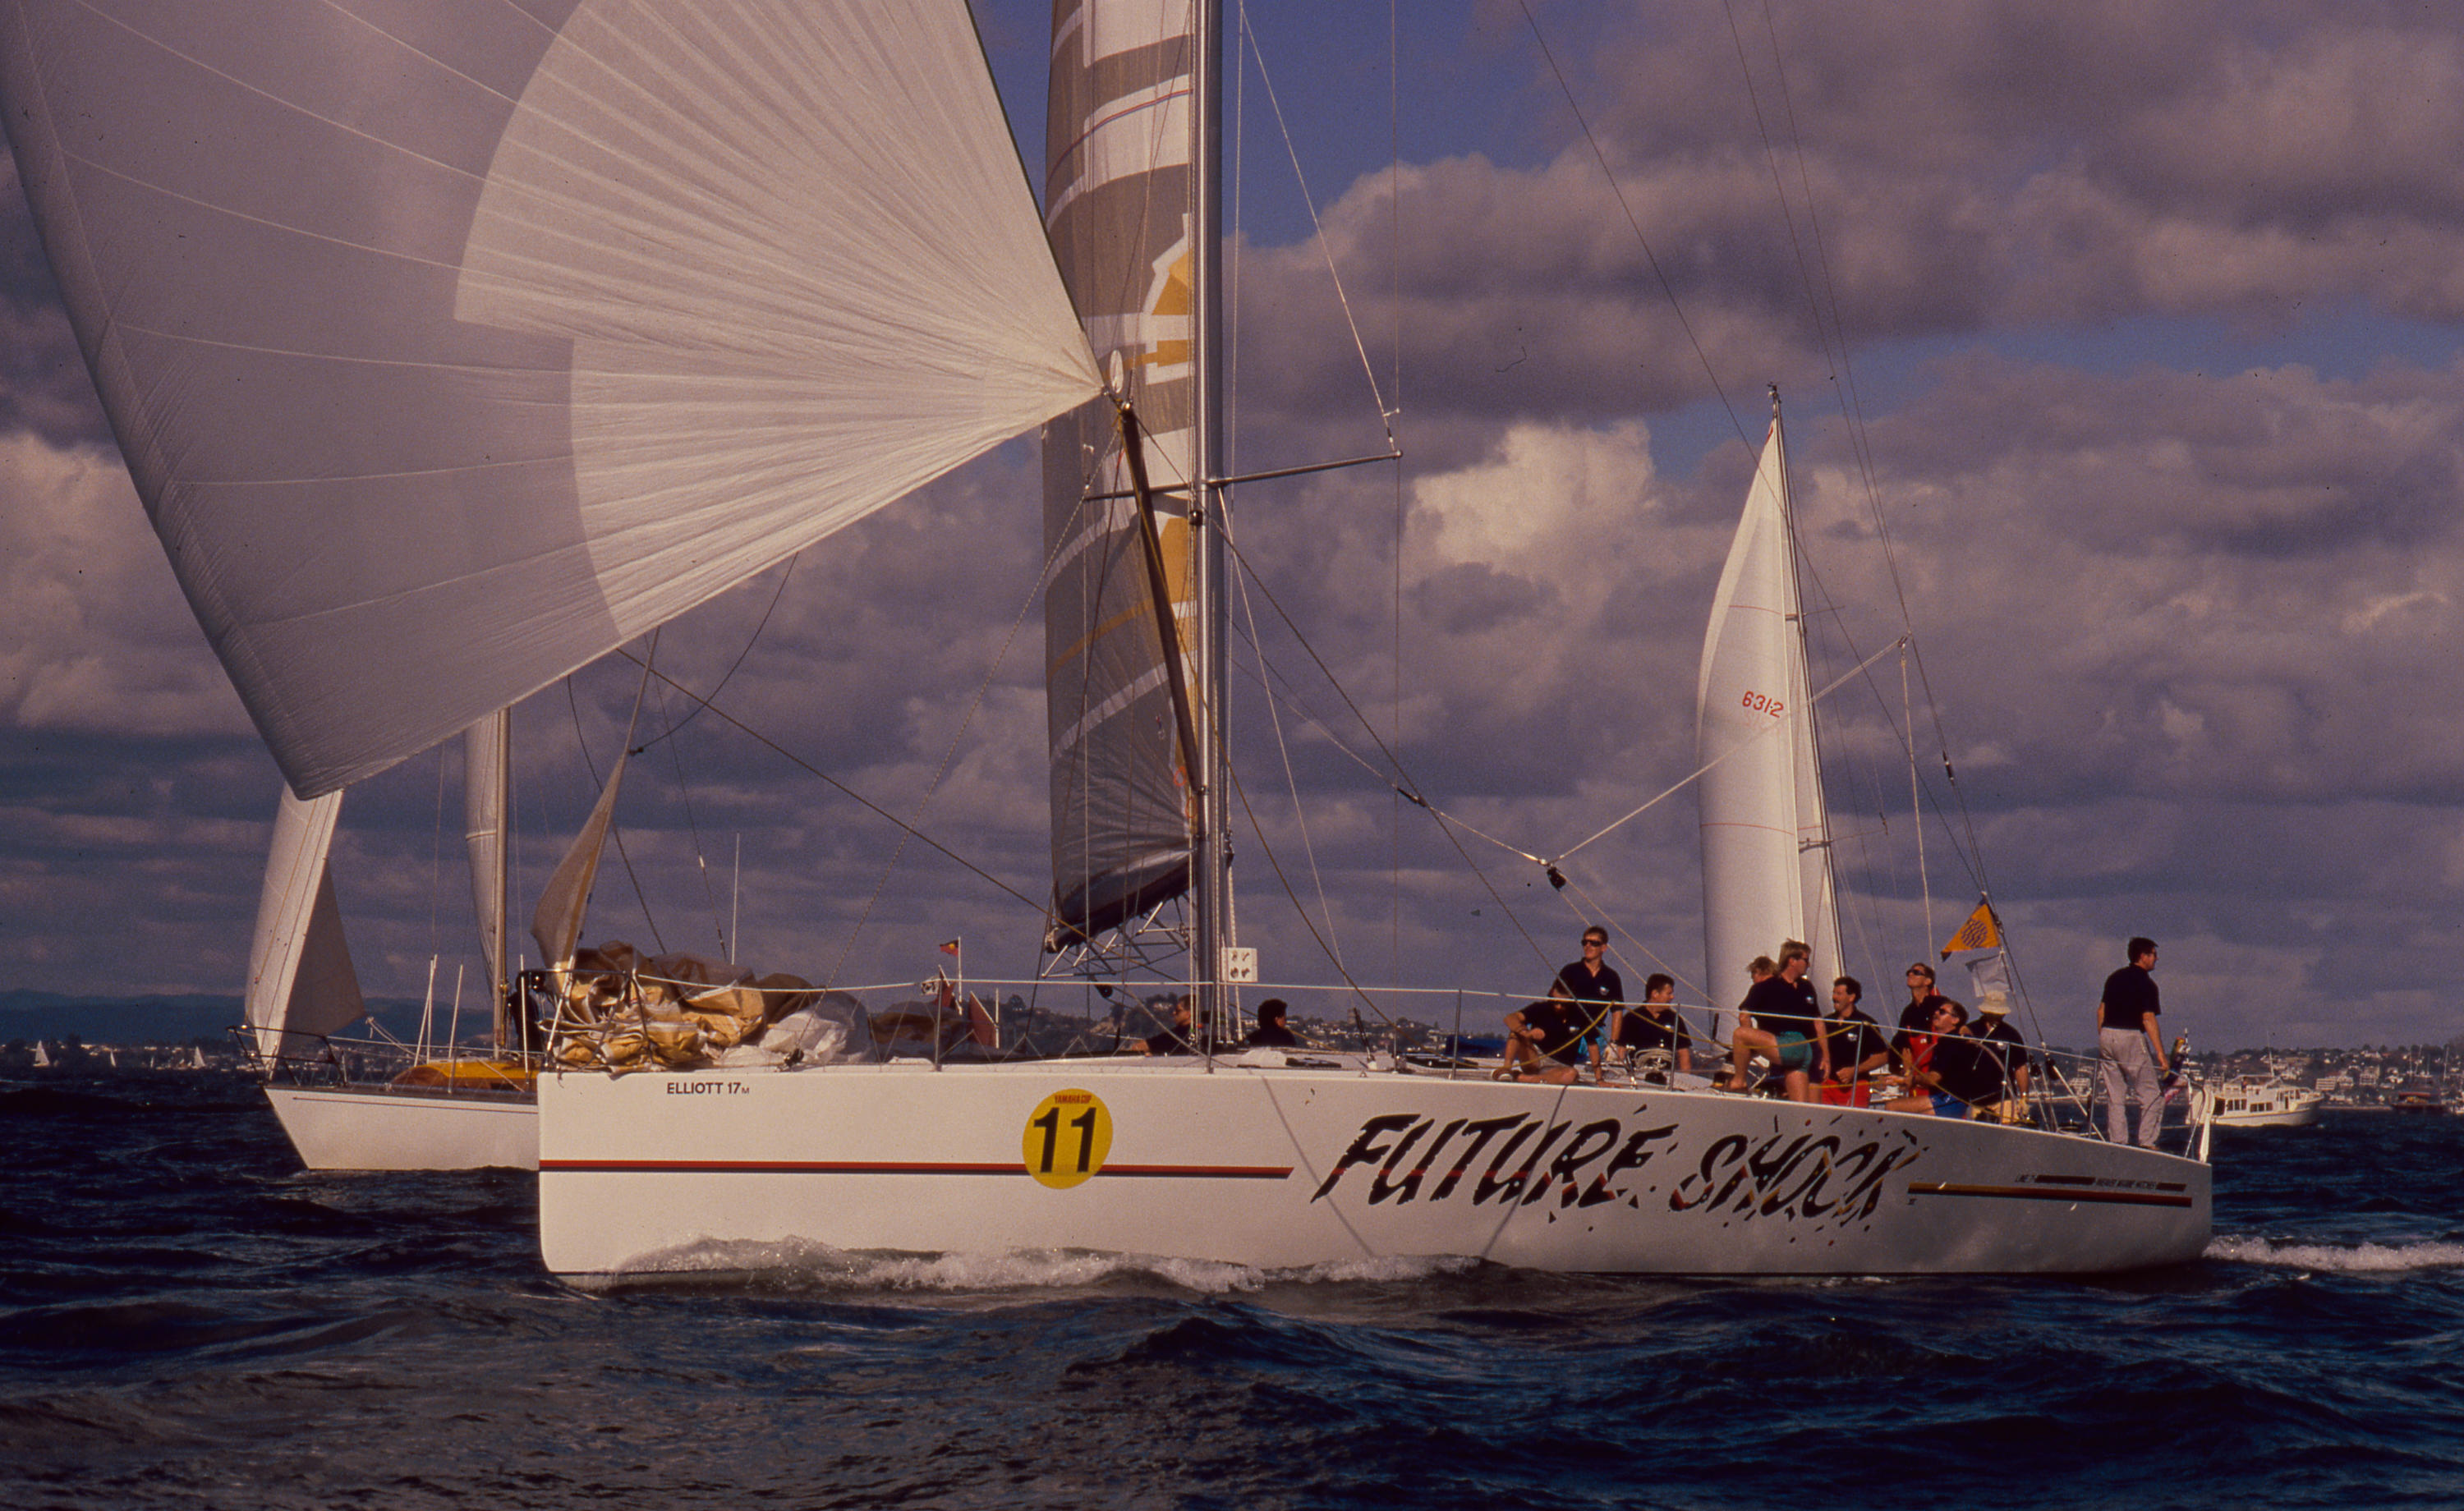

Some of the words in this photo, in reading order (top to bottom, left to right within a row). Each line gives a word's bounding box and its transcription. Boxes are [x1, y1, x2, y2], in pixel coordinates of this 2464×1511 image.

[1742, 690, 1784, 719] 6312
[667, 1082, 723, 1094] ELLIOTT
[1033, 1106, 1096, 1173] 11
[1310, 1112, 1680, 1208] FUTURE
[1668, 1132, 1920, 1221] SHOCK
